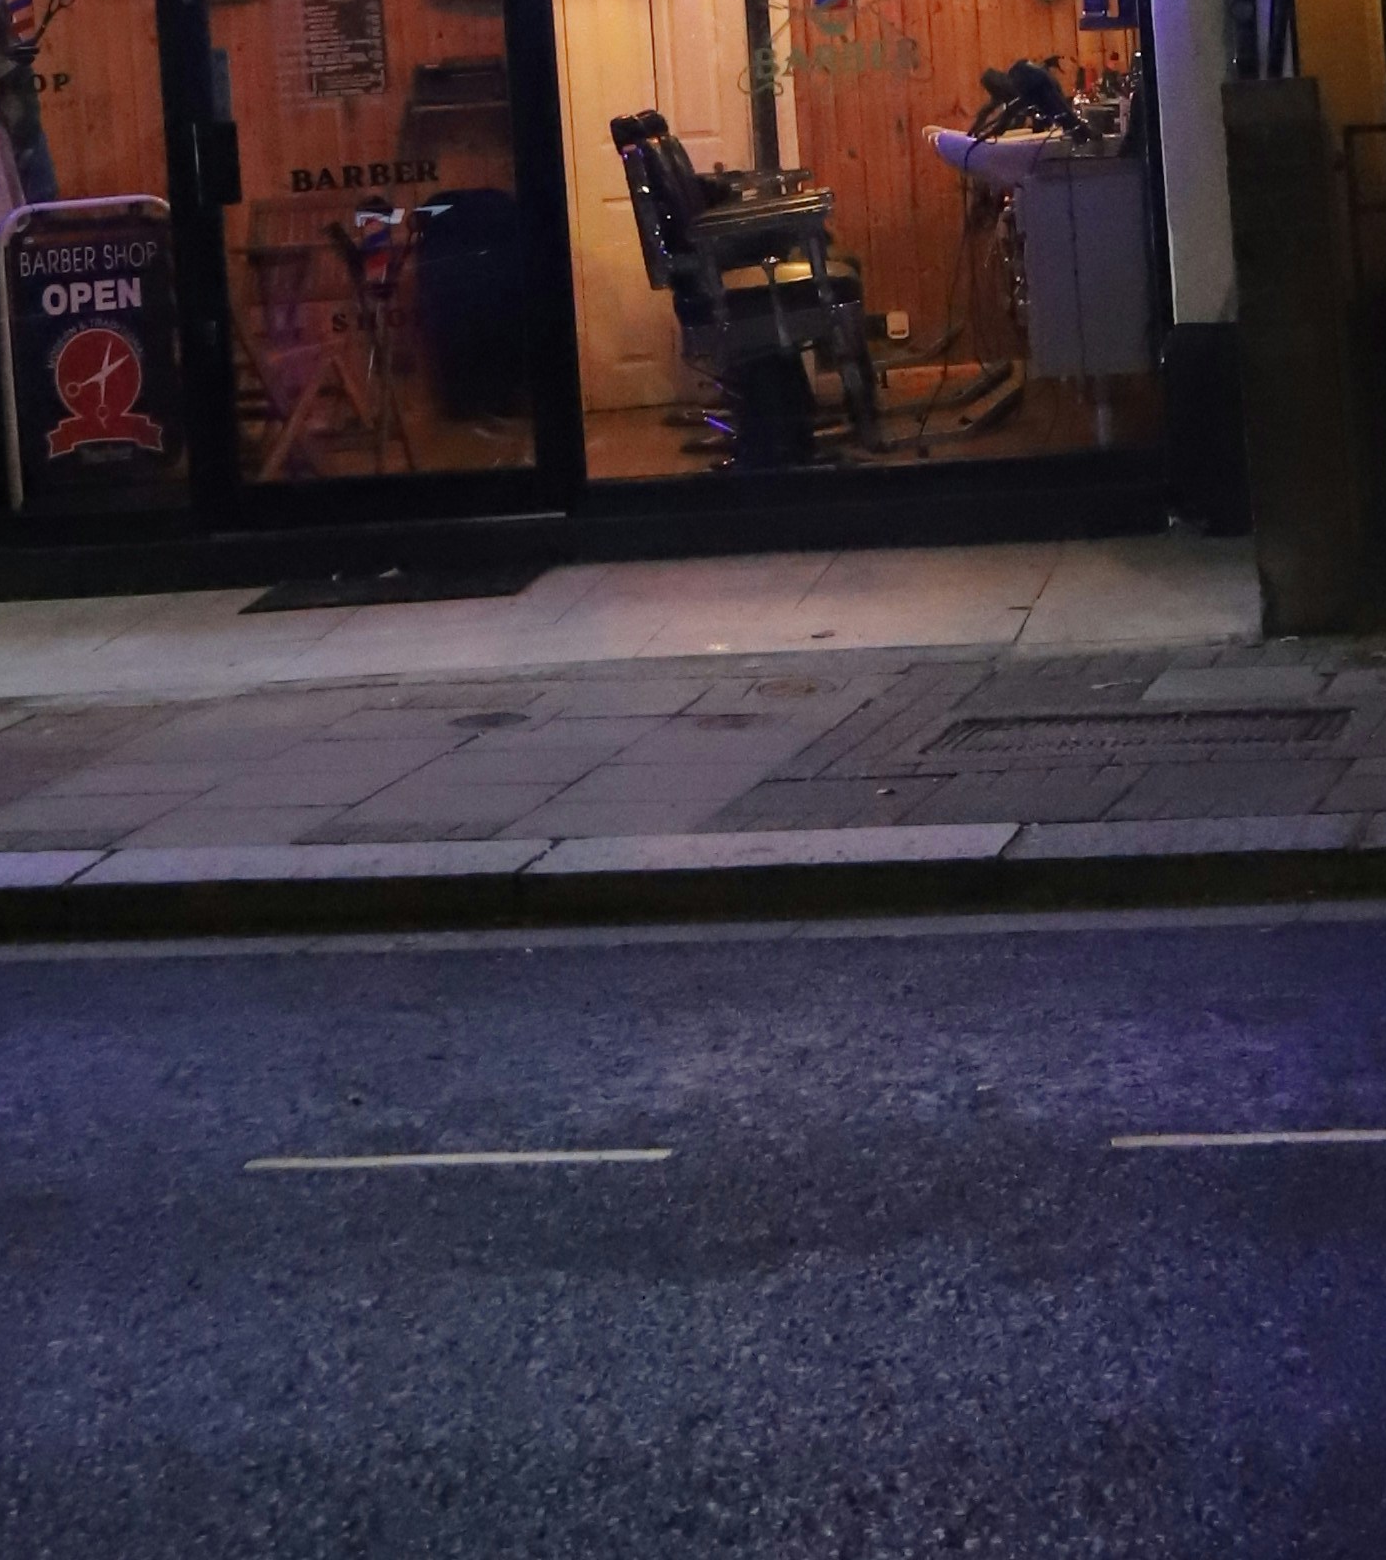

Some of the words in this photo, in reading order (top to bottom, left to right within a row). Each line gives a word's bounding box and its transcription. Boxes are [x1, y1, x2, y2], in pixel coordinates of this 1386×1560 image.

[291, 161, 439, 193] BARBER
[19, 245, 97, 277] BARBER
[103, 241, 158, 271] SHOP
[41, 277, 143, 316] OPEN
